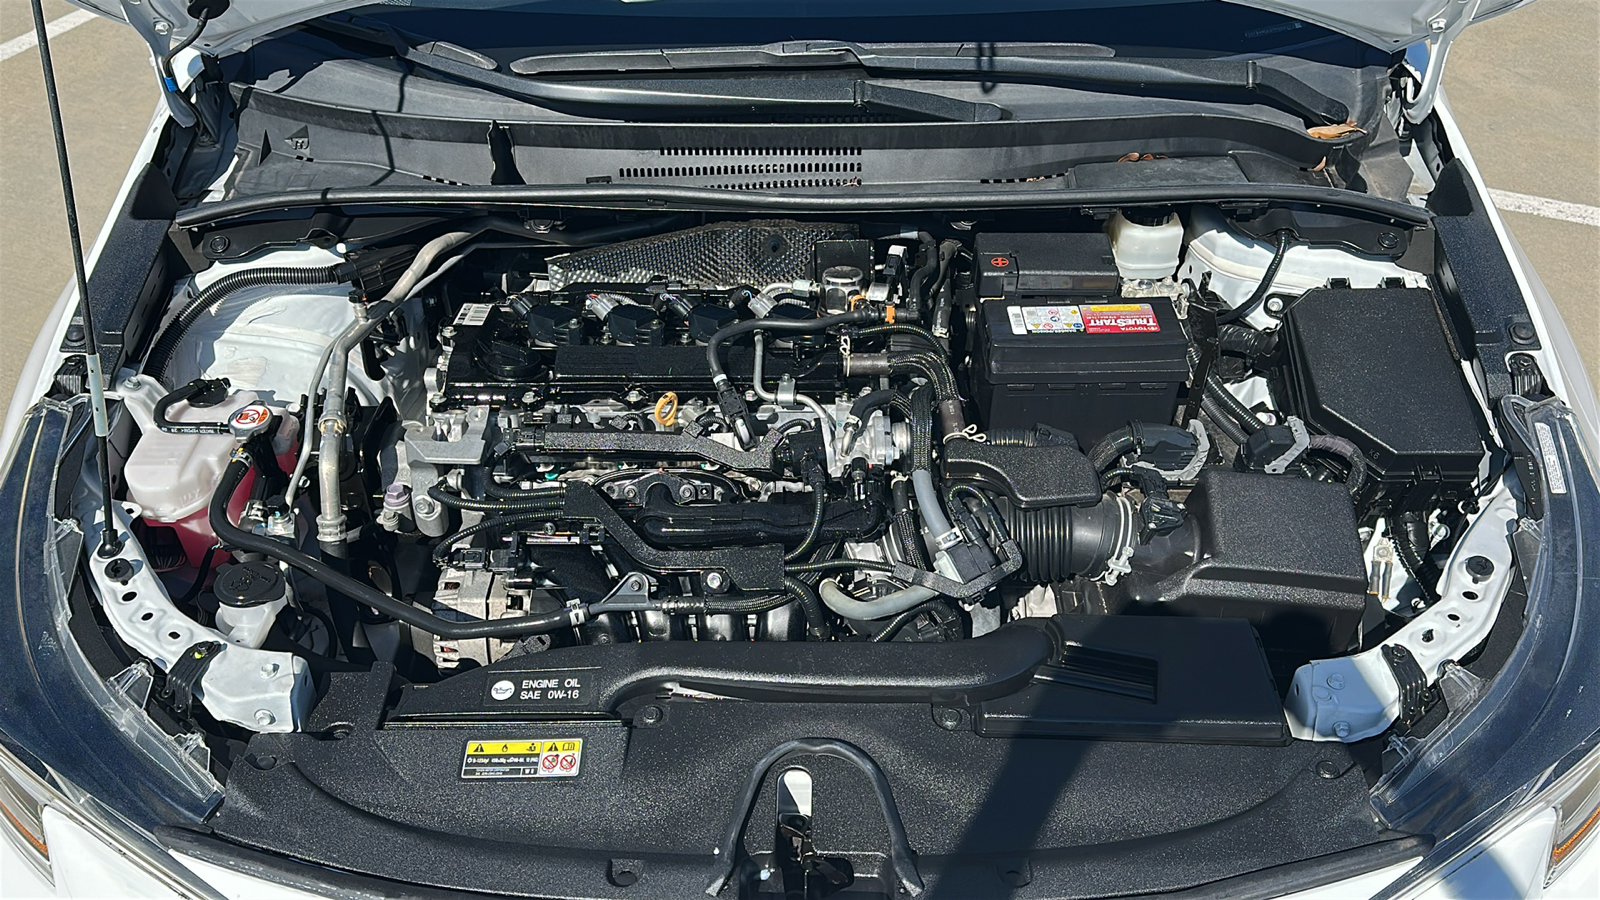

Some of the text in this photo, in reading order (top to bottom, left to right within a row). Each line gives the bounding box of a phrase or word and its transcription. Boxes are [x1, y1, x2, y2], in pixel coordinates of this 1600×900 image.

[522, 678, 581, 689] ENGINE OIL
[520, 690, 579, 700] SAE 0W-16
